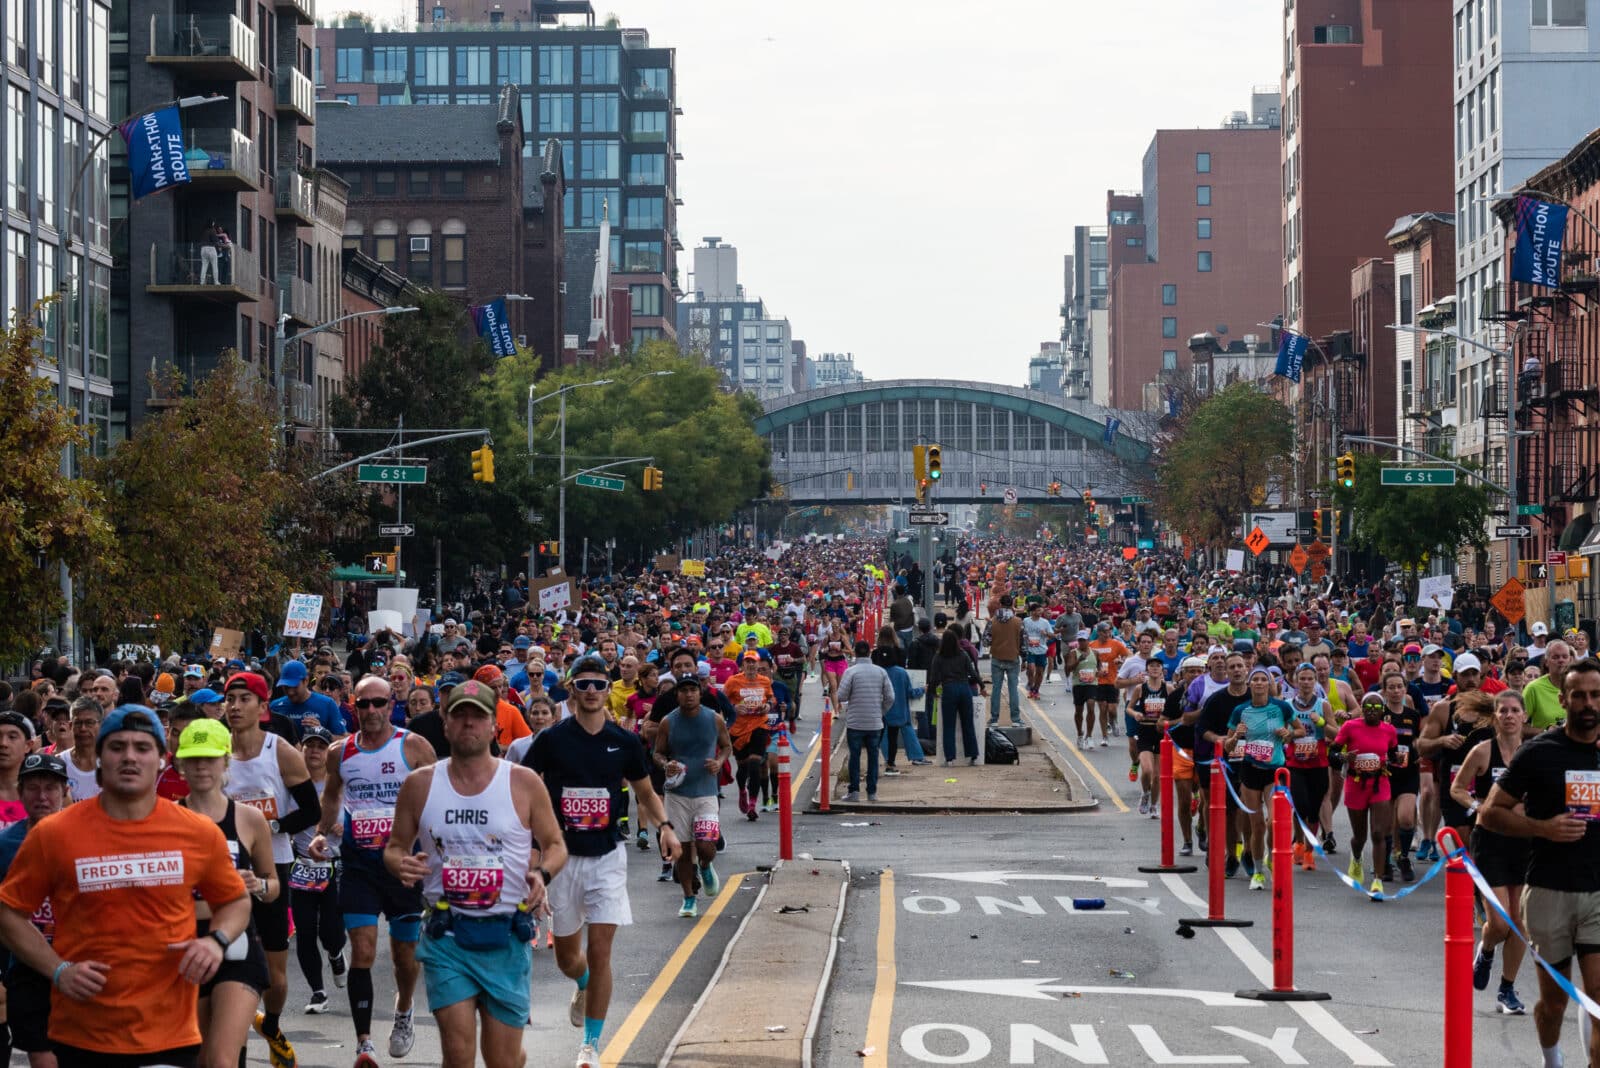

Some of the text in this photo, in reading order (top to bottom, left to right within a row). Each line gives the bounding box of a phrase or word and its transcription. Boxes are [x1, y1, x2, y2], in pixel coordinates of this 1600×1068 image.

[167, 134, 187, 182] ROUTE
[1532, 204, 1549, 283] MARATHON
[1546, 239, 1560, 287] ROUTE
[500, 322, 515, 355] ROUTE
[380, 469, 407, 479] 6 St
[1405, 472, 1432, 482] 6 St
[930, 515, 944, 523] WAY
[381, 762, 396, 774] 25
[359, 791, 374, 800] FOR
[563, 798, 608, 813] 30538
[444, 809, 489, 825] CHRIS
[81, 860, 179, 880] FRED'S TEAM
[295, 865, 328, 880] 29513
[447, 869, 497, 888] 38751
[902, 895, 1165, 916] ONLY
[900, 1023, 1309, 1066] ONLY
